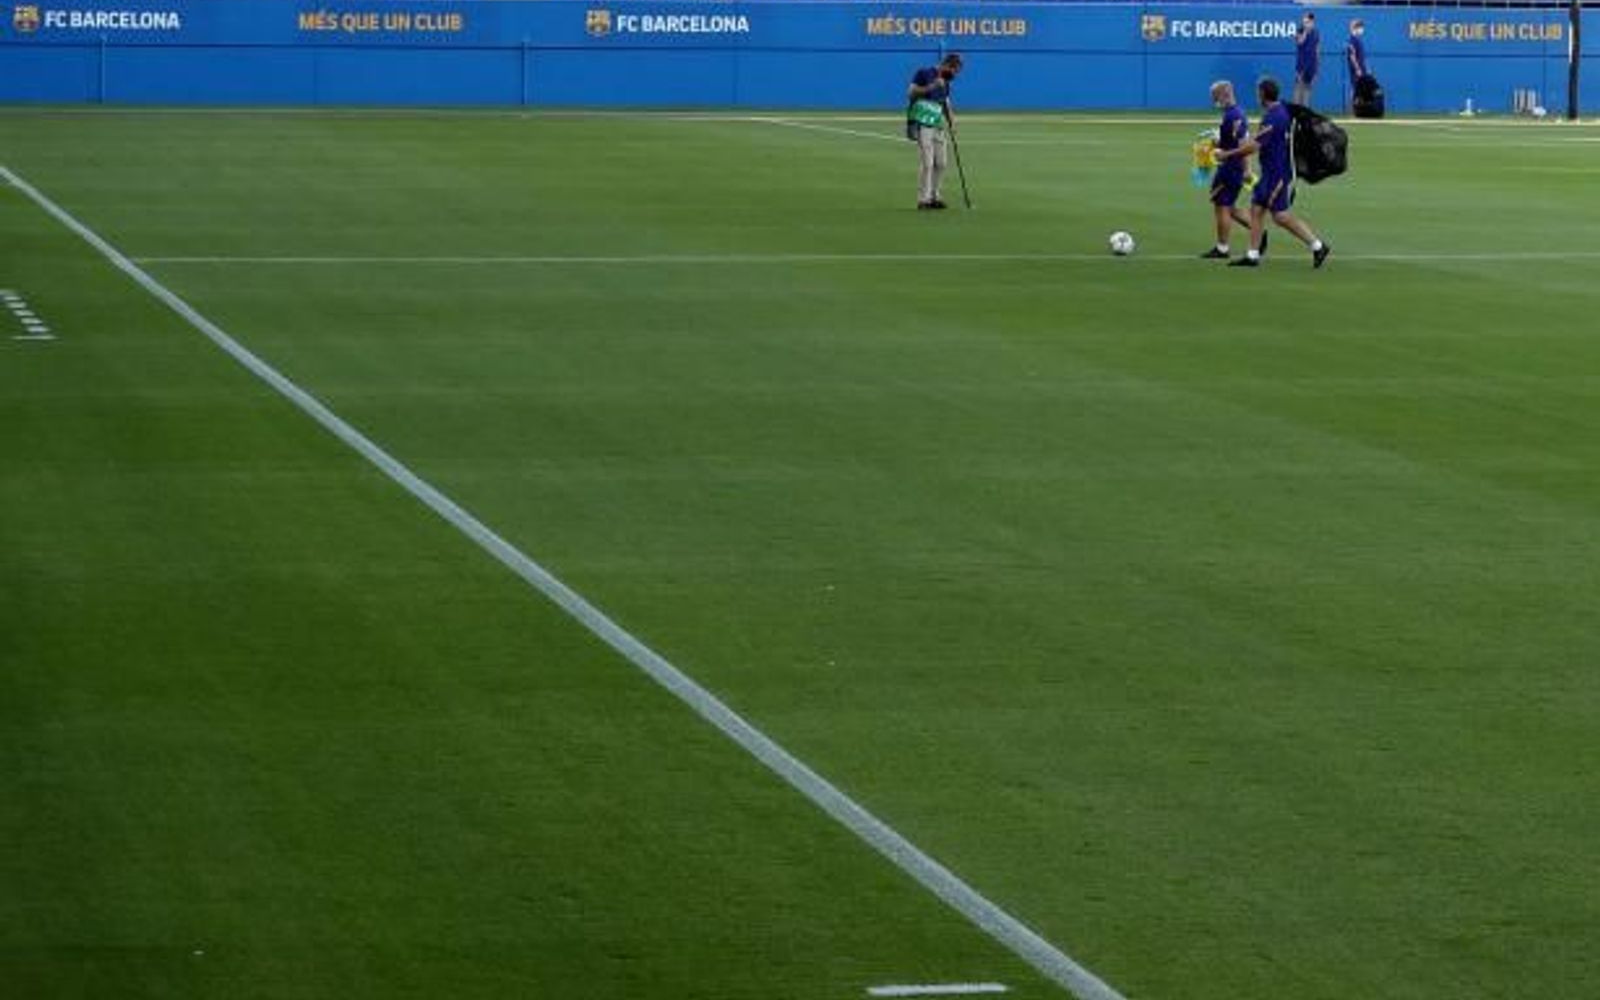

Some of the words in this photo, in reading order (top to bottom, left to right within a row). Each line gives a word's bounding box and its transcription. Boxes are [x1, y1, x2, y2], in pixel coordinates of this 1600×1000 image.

[46, 11, 67, 28] FC
[70, 11, 180, 29] BARCELONA
[342, 13, 379, 33] QUE
[383, 13, 410, 30] UN
[415, 13, 463, 31] CLUB
[617, 15, 638, 32] FC
[641, 15, 750, 32] BARCELONA
[909, 18, 947, 37] QUE
[950, 19, 976, 35] UN
[979, 19, 1026, 35] CLUB
[1171, 20, 1192, 37] FC
[1195, 20, 1298, 38] BARCELONA
[1451, 23, 1487, 42] QUE
[1490, 23, 1516, 40] UN
[1519, 23, 1563, 40] CLUB
